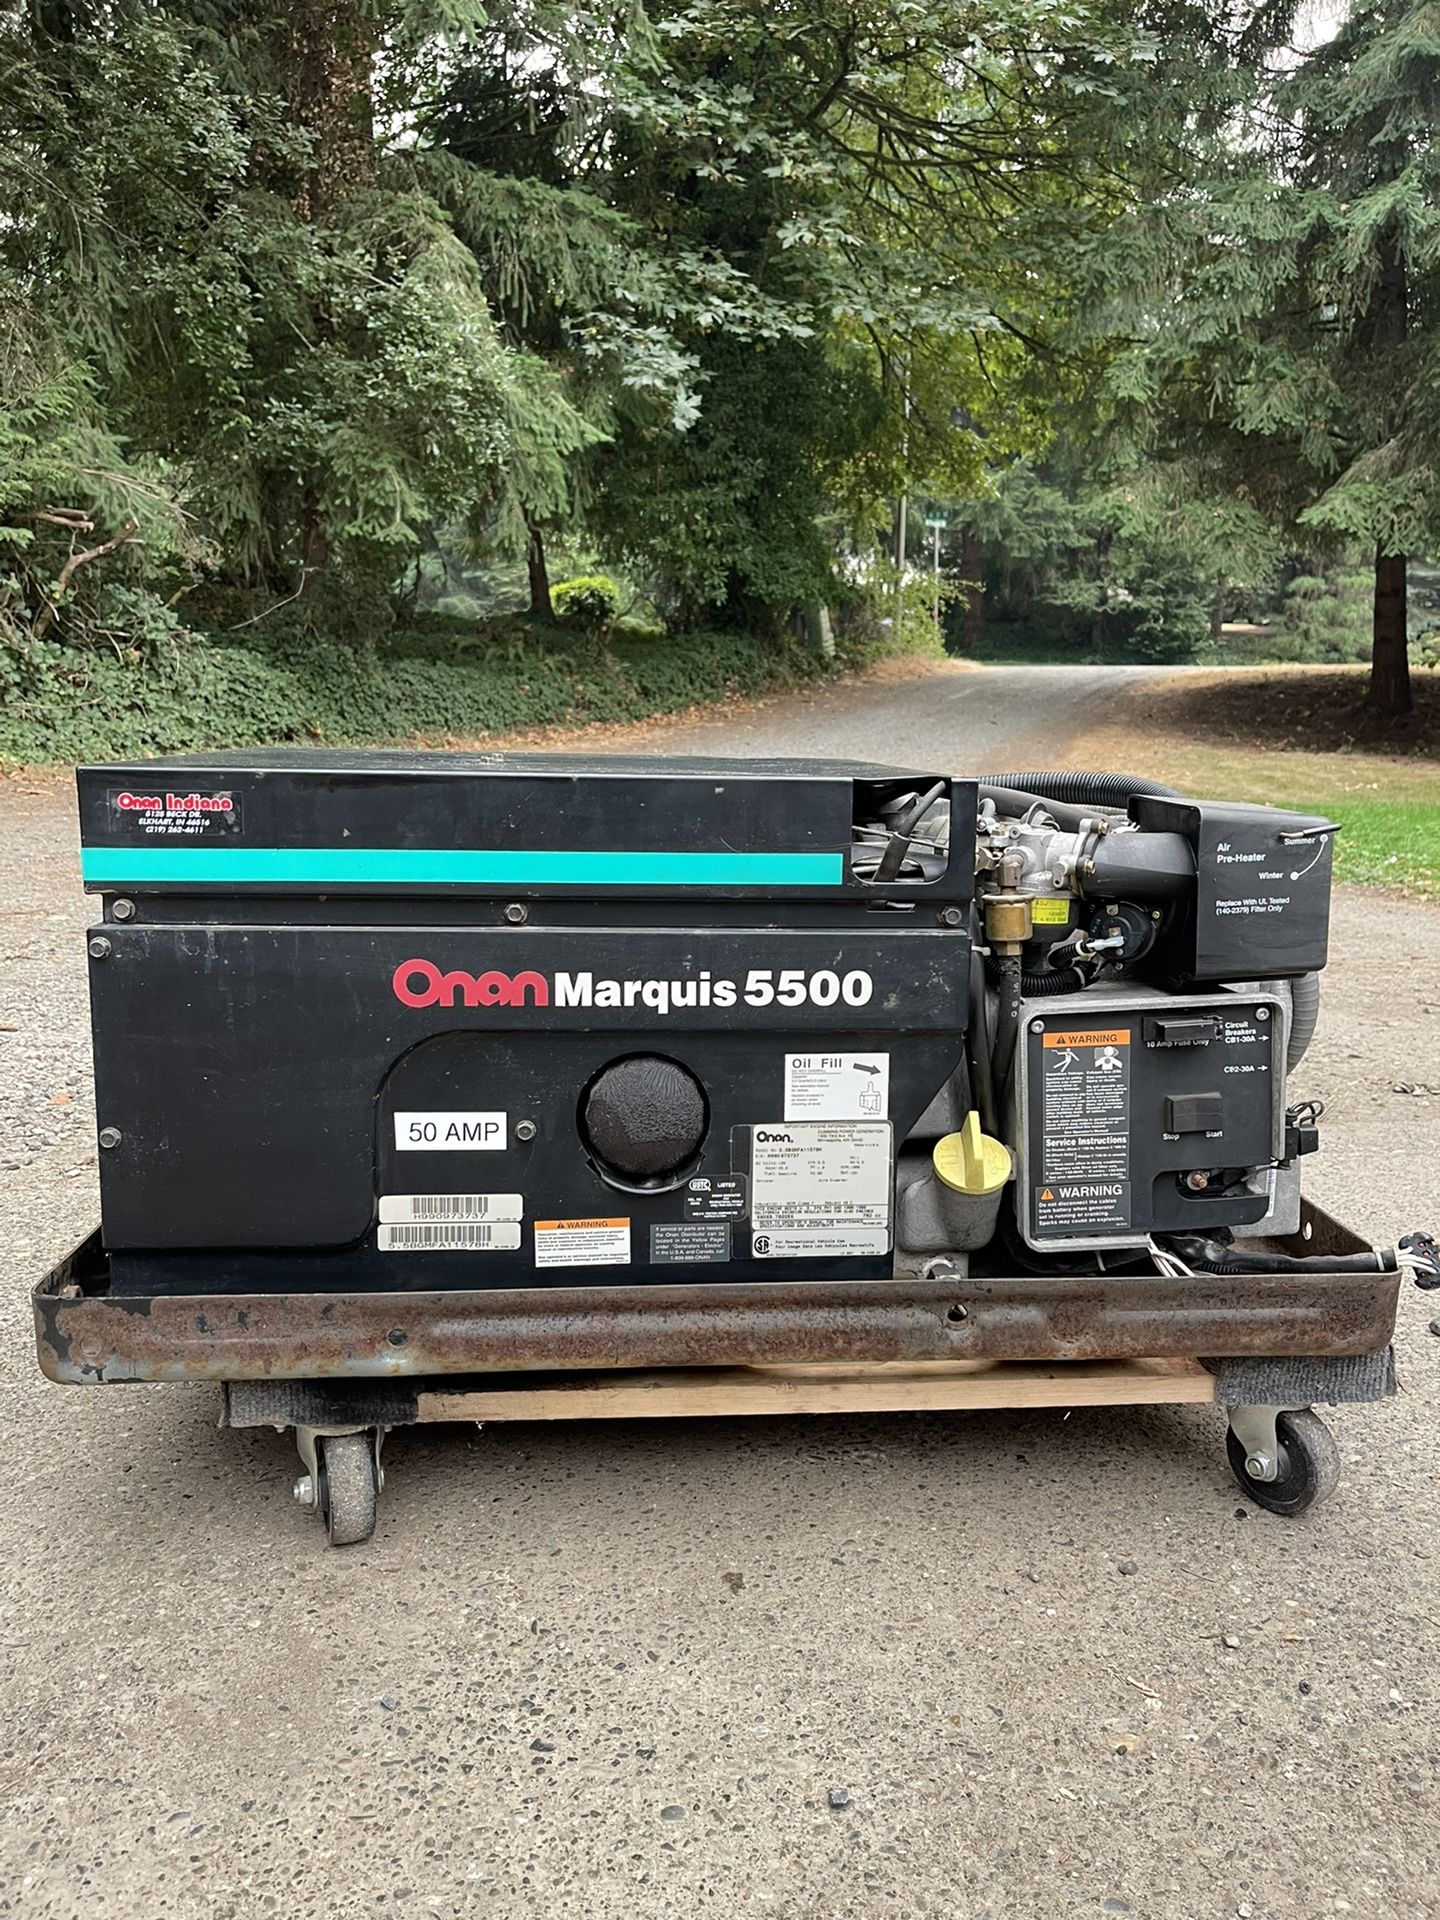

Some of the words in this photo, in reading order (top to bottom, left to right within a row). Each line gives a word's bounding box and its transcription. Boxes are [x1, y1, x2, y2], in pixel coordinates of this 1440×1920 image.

[118, 793, 162, 811] Onan
[166, 794, 233, 811] Indiana
[138, 818, 174, 826] ELKHART,
[1284, 837, 1316, 846] Summer
[1217, 843, 1231, 852] Air
[1216, 853, 1266, 863] Pre-Heater
[1258, 872, 1284, 880] Winter
[1215, 900, 1242, 908] Replace
[1268, 905, 1283, 913] Only
[392, 958, 549, 1009] Onan
[554, 971, 737, 1014] Marquis
[743, 970, 874, 1008] 5500
[1225, 1021, 1249, 1029] Circuit
[1069, 1034, 1118, 1044] WARNING
[1156, 1040, 1173, 1048] Amp
[792, 1058, 811, 1069] Oil
[821, 1058, 842, 1068] Fill
[409, 1122, 437, 1142] 50
[445, 1122, 499, 1141] AMP
[756, 1131, 791, 1142] Onan
[1046, 1138, 1076, 1147] Service
[1078, 1136, 1127, 1146] Instructions
[1162, 1133, 1180, 1141] Stop
[1059, 1184, 1123, 1198] WARNING
[566, 1220, 608, 1229] WARNING
